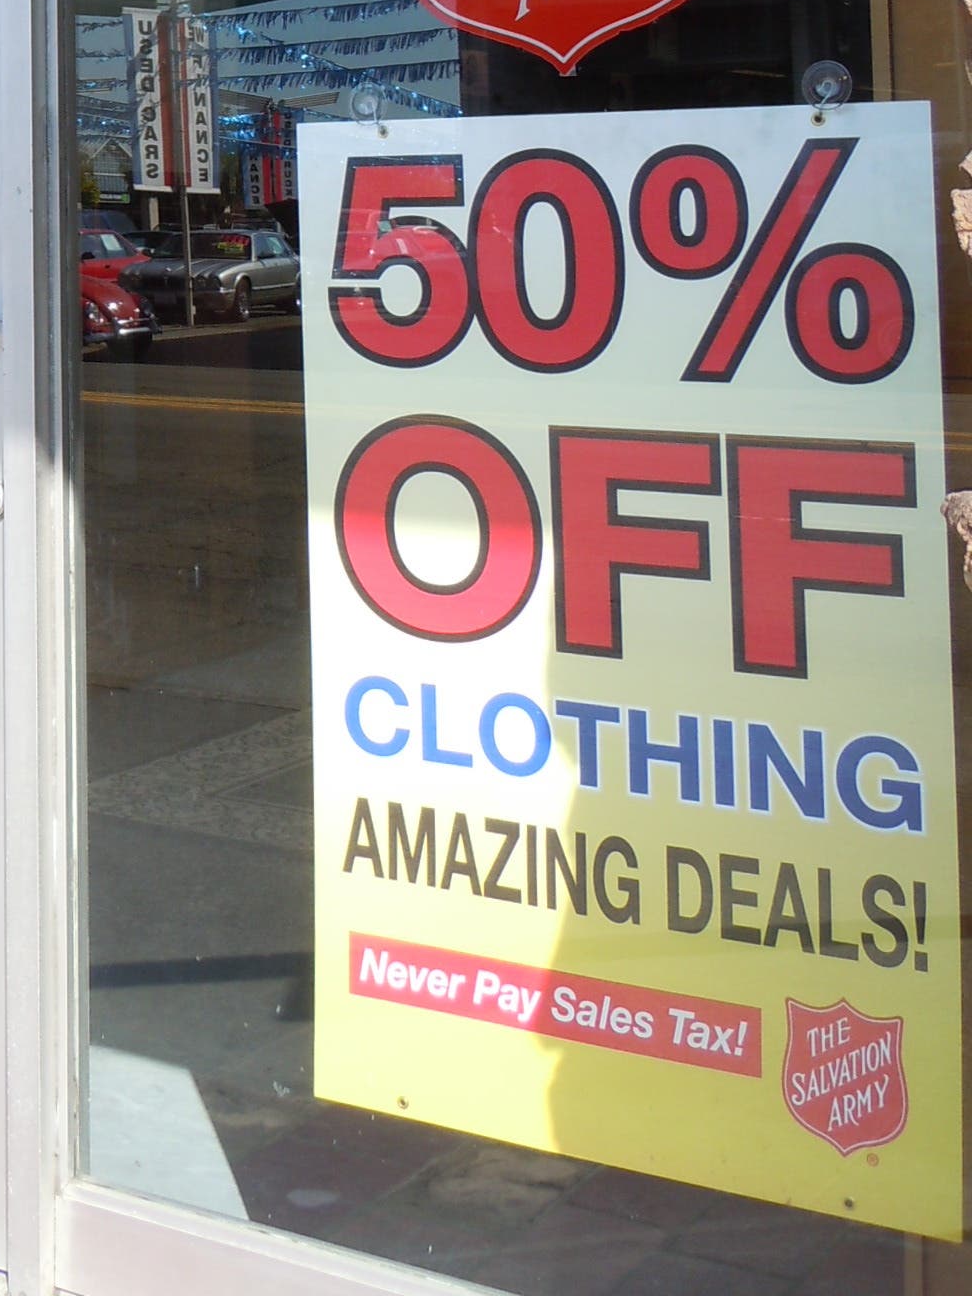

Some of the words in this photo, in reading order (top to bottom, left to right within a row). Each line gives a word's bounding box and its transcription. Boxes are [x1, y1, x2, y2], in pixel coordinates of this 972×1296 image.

[328, 136, 915, 385] 50%
[334, 414, 918, 679] OFF
[344, 675, 926, 834] CLOTHING
[343, 797, 641, 925] AMAZING
[666, 845, 928, 972] DEALS!
[358, 947, 466, 1000] Never
[472, 969, 541, 1024] Pay
[550, 986, 654, 1040] Sales
[667, 1007, 749, 1057] Tax!
[791, 1031, 892, 1106] SALVATION
[807, 1017, 851, 1057] THE
[828, 1074, 889, 1132] ARMY
